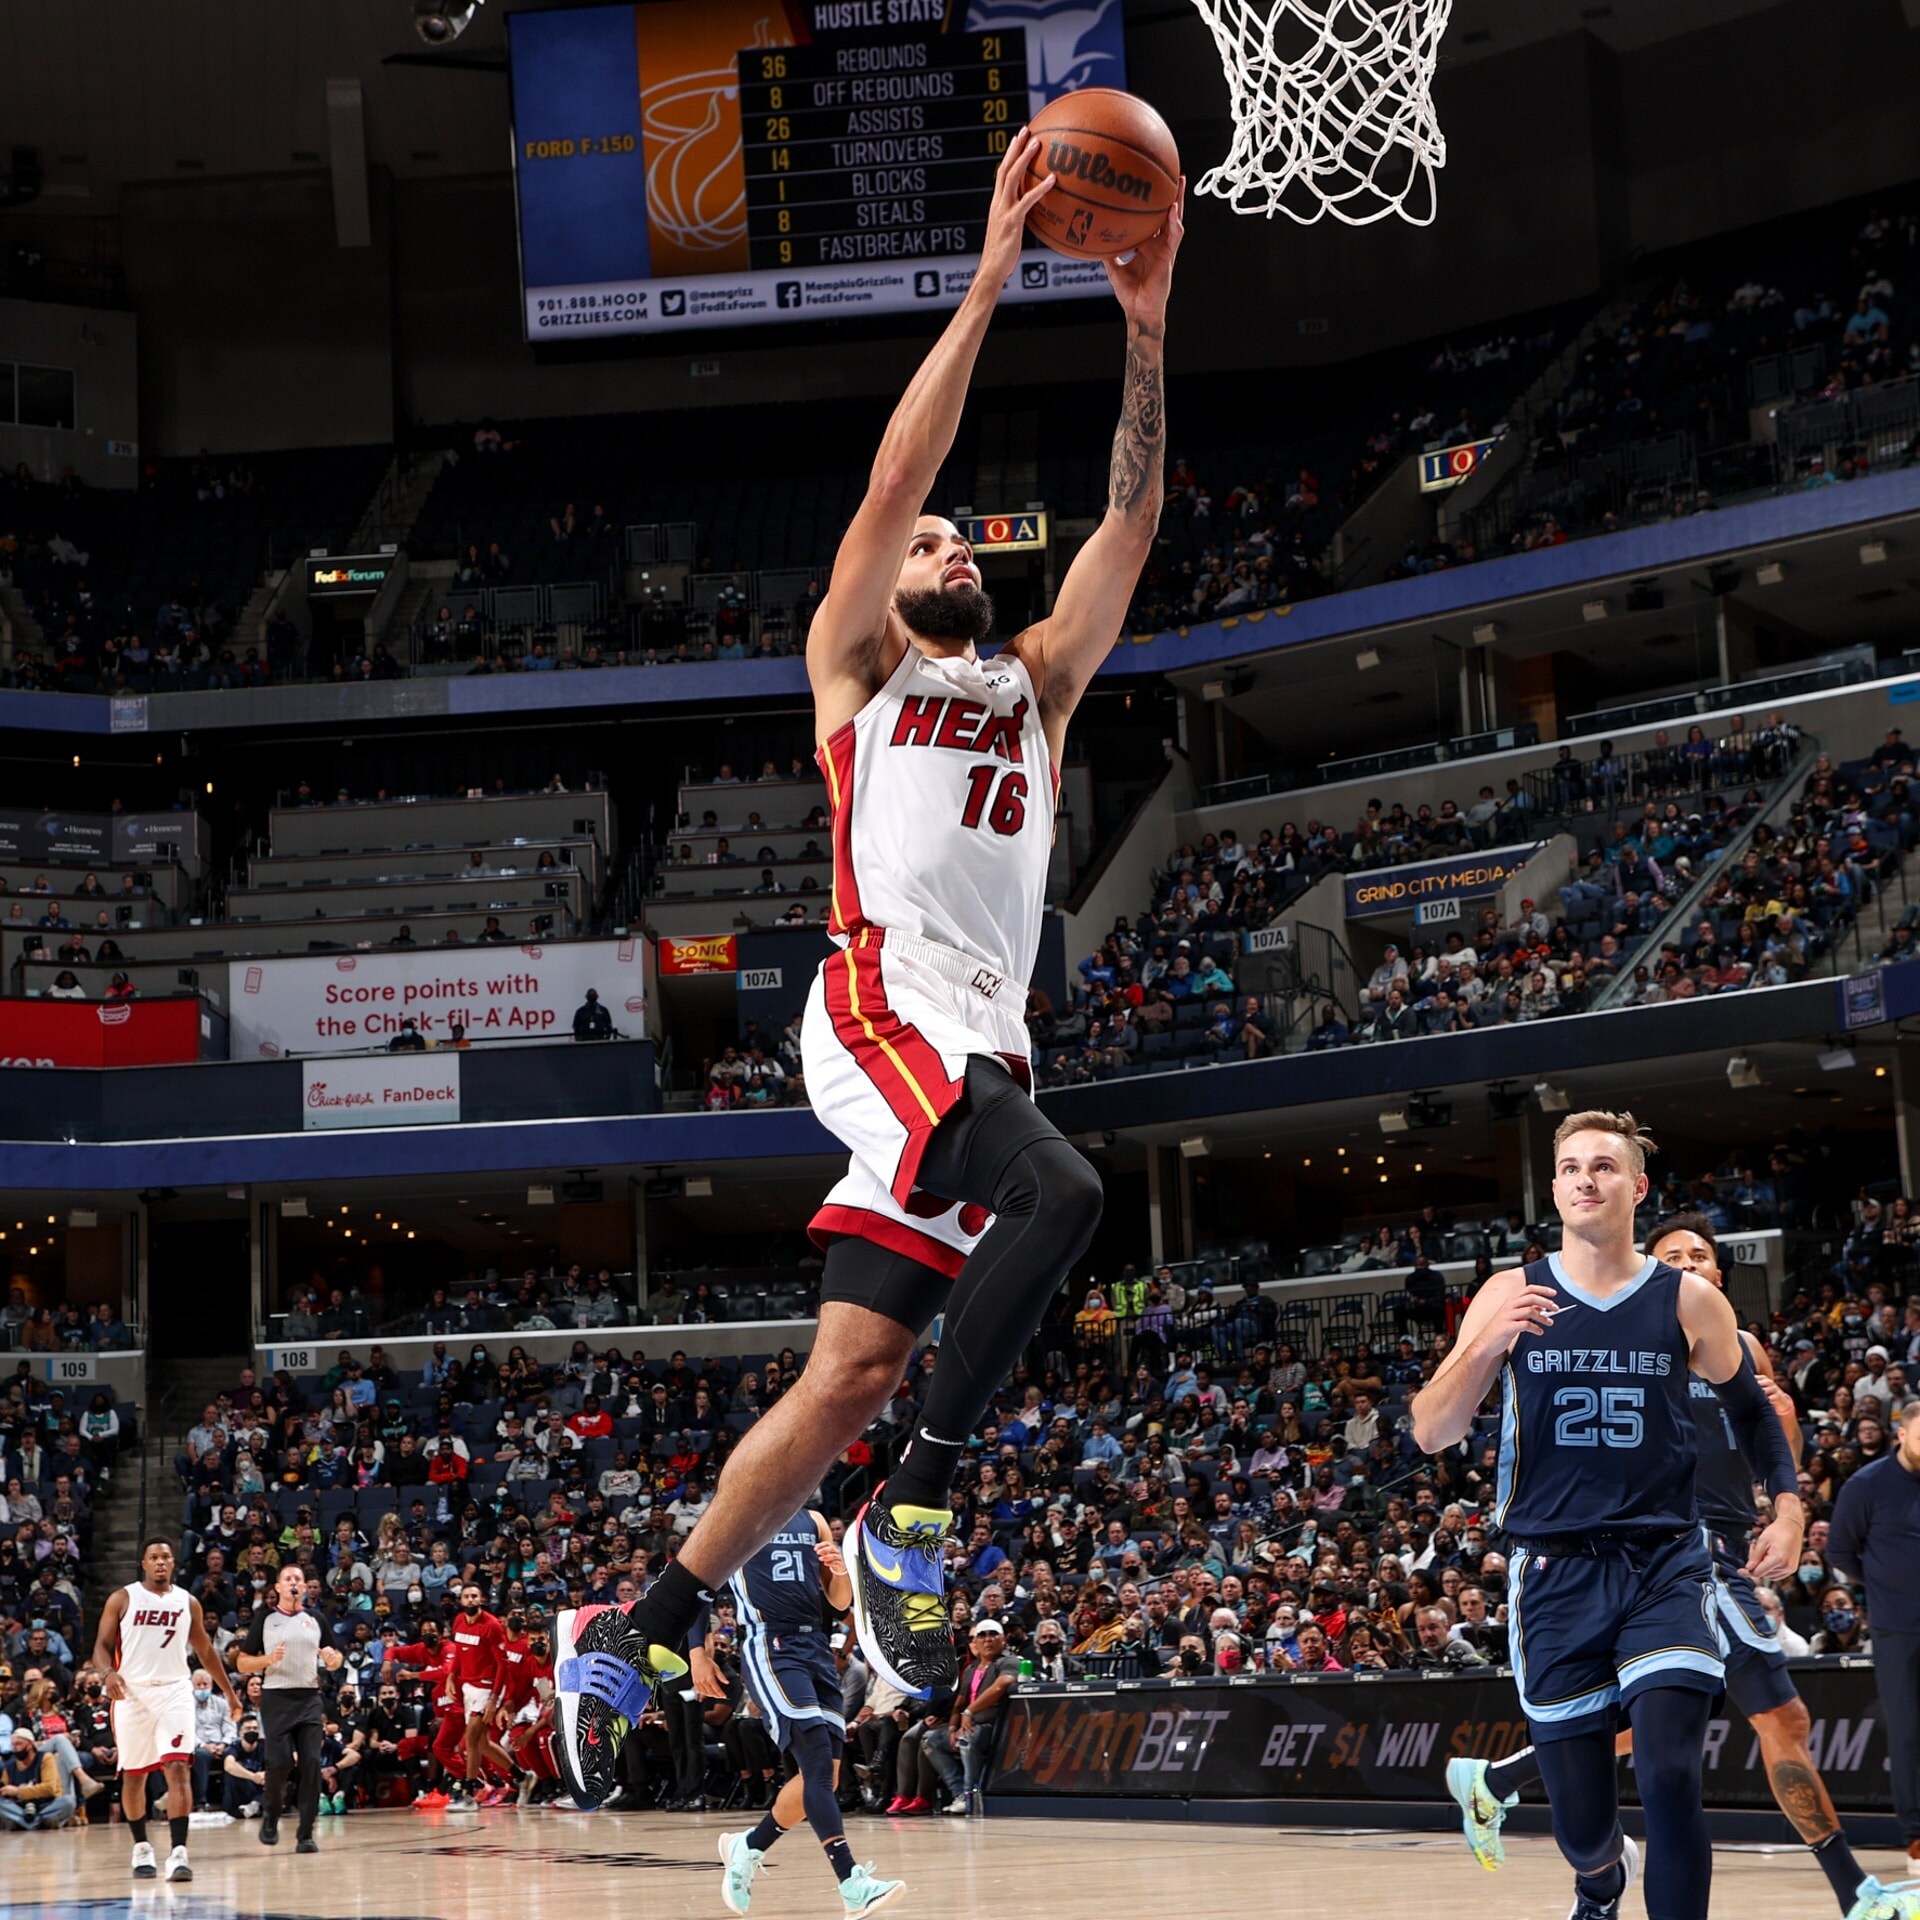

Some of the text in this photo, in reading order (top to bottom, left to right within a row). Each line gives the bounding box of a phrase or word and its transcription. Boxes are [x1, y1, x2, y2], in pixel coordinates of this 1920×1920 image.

[814, 0, 944, 29] HUSTLE STATS
[836, 43, 927, 73] REBOUNDS
[982, 37, 1001, 60] 21
[762, 55, 786, 79] 36
[813, 72, 954, 107] OFF REBOUNDS
[988, 68, 1000, 91] 6
[770, 86, 782, 109] 8
[847, 105, 924, 134] ASSISTS
[982, 99, 1008, 123] 20
[766, 117, 790, 141] 26
[526, 134, 634, 158] FORD F-150
[831, 136, 943, 167] TURNOVERS
[988, 130, 1007, 154] 10
[772, 148, 790, 171] 14
[1046, 139, 1152, 202] Wilson
[852, 168, 926, 197] BLOCKS
[778, 210, 790, 232] 8
[856, 199, 925, 227] STEALS
[780, 240, 792, 263] 9
[819, 226, 966, 261] FASTBREAK PTS
[537, 292, 648, 311] 901.888.HOOP
[539, 308, 648, 327] GRIZZLIES.COM
[1433, 445, 1490, 479] IO
[968, 519, 1035, 542] IOA
[315, 569, 384, 584] FedExForum
[889, 694, 1029, 763] HEAT
[960, 765, 1028, 836] 16
[1356, 883, 1406, 904] GRIND
[1408, 875, 1448, 896] CITY
[1423, 902, 1456, 920] 107A
[676, 943, 727, 958] SONIC
[1253, 930, 1284, 948] 107A
[325, 973, 539, 1005] Score points with
[744, 971, 778, 987] 107A
[316, 1016, 357, 1037] the
[508, 1006, 556, 1030] App
[383, 1085, 455, 1103] FanDeck
[60, 1361, 87, 1378] 109
[281, 1351, 309, 1367] 108
[1527, 1349, 1672, 1376] GRIZZLIES
[1553, 1386, 1645, 1449] 25
[771, 1550, 805, 1582] 21
[133, 1608, 184, 1627] HEAT
[160, 1629, 176, 1648] 7
[1260, 1724, 1327, 1767] BET
[1329, 1721, 1369, 1769] $1
[1375, 1723, 1440, 1767] WIN
